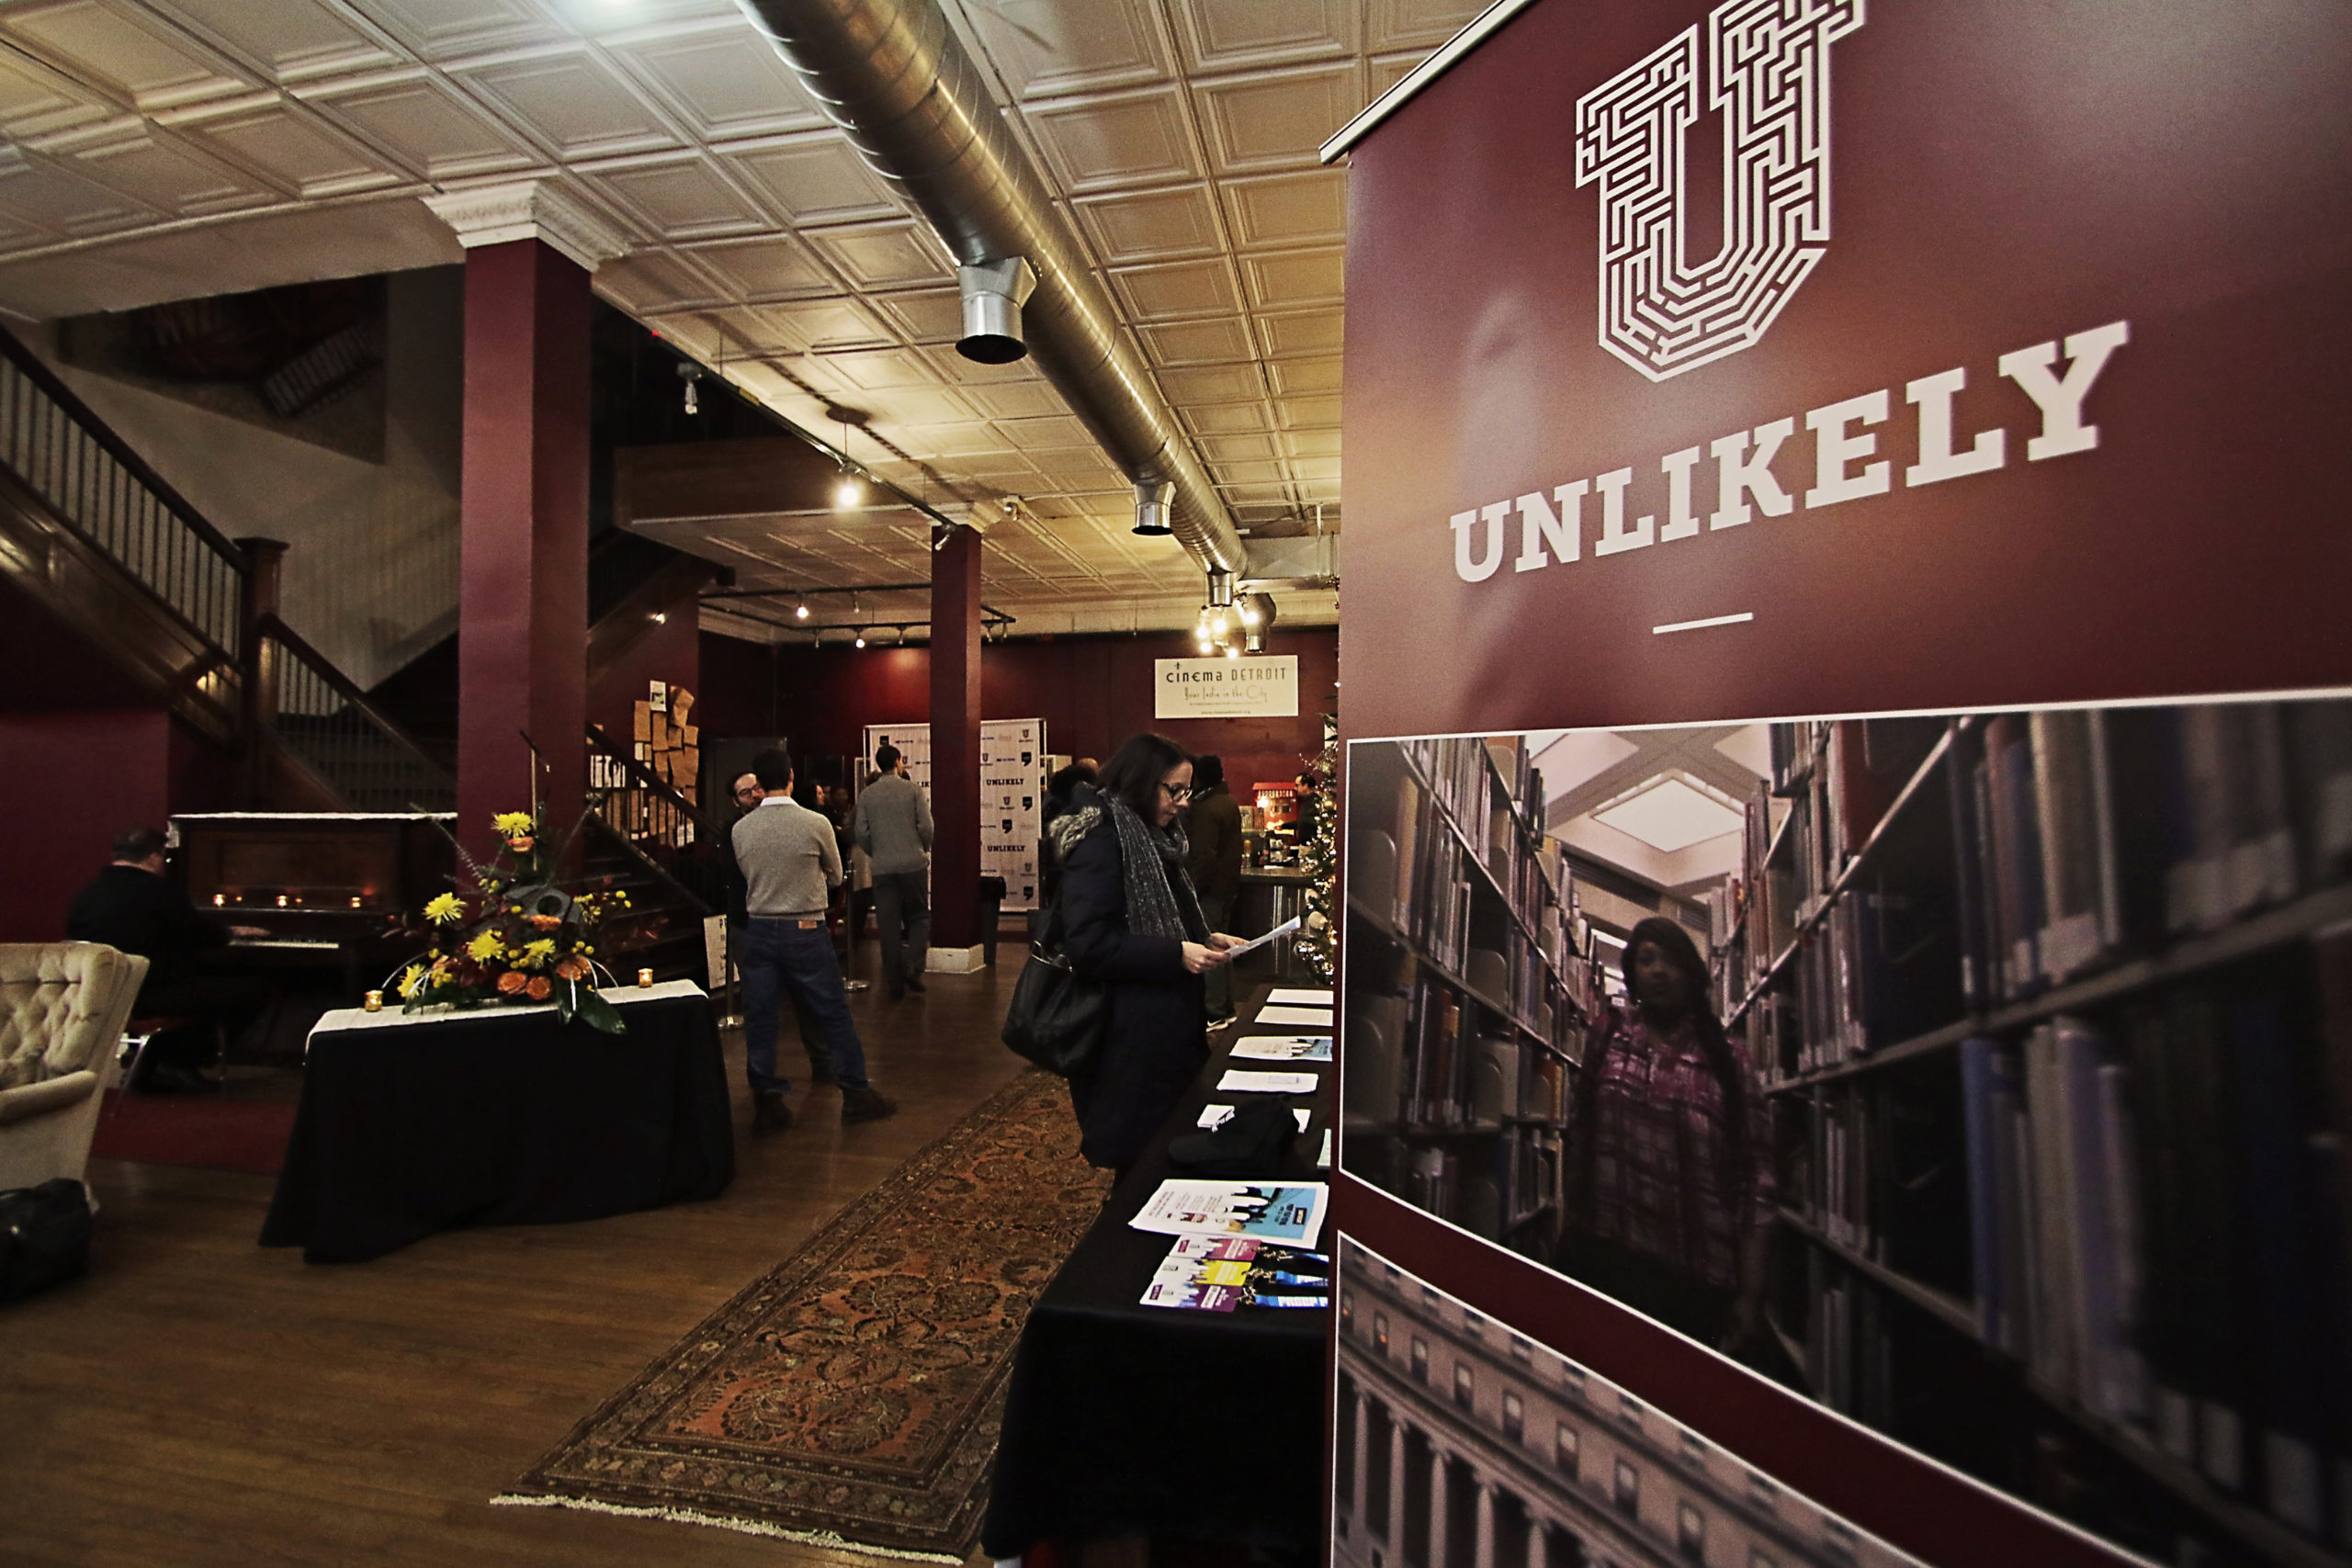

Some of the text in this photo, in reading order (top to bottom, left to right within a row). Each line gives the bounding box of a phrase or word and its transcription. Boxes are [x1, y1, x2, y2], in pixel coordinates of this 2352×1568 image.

[1450, 320, 2130, 583] UNLIKELY
[1166, 662, 1286, 683] cinema DETROIT
